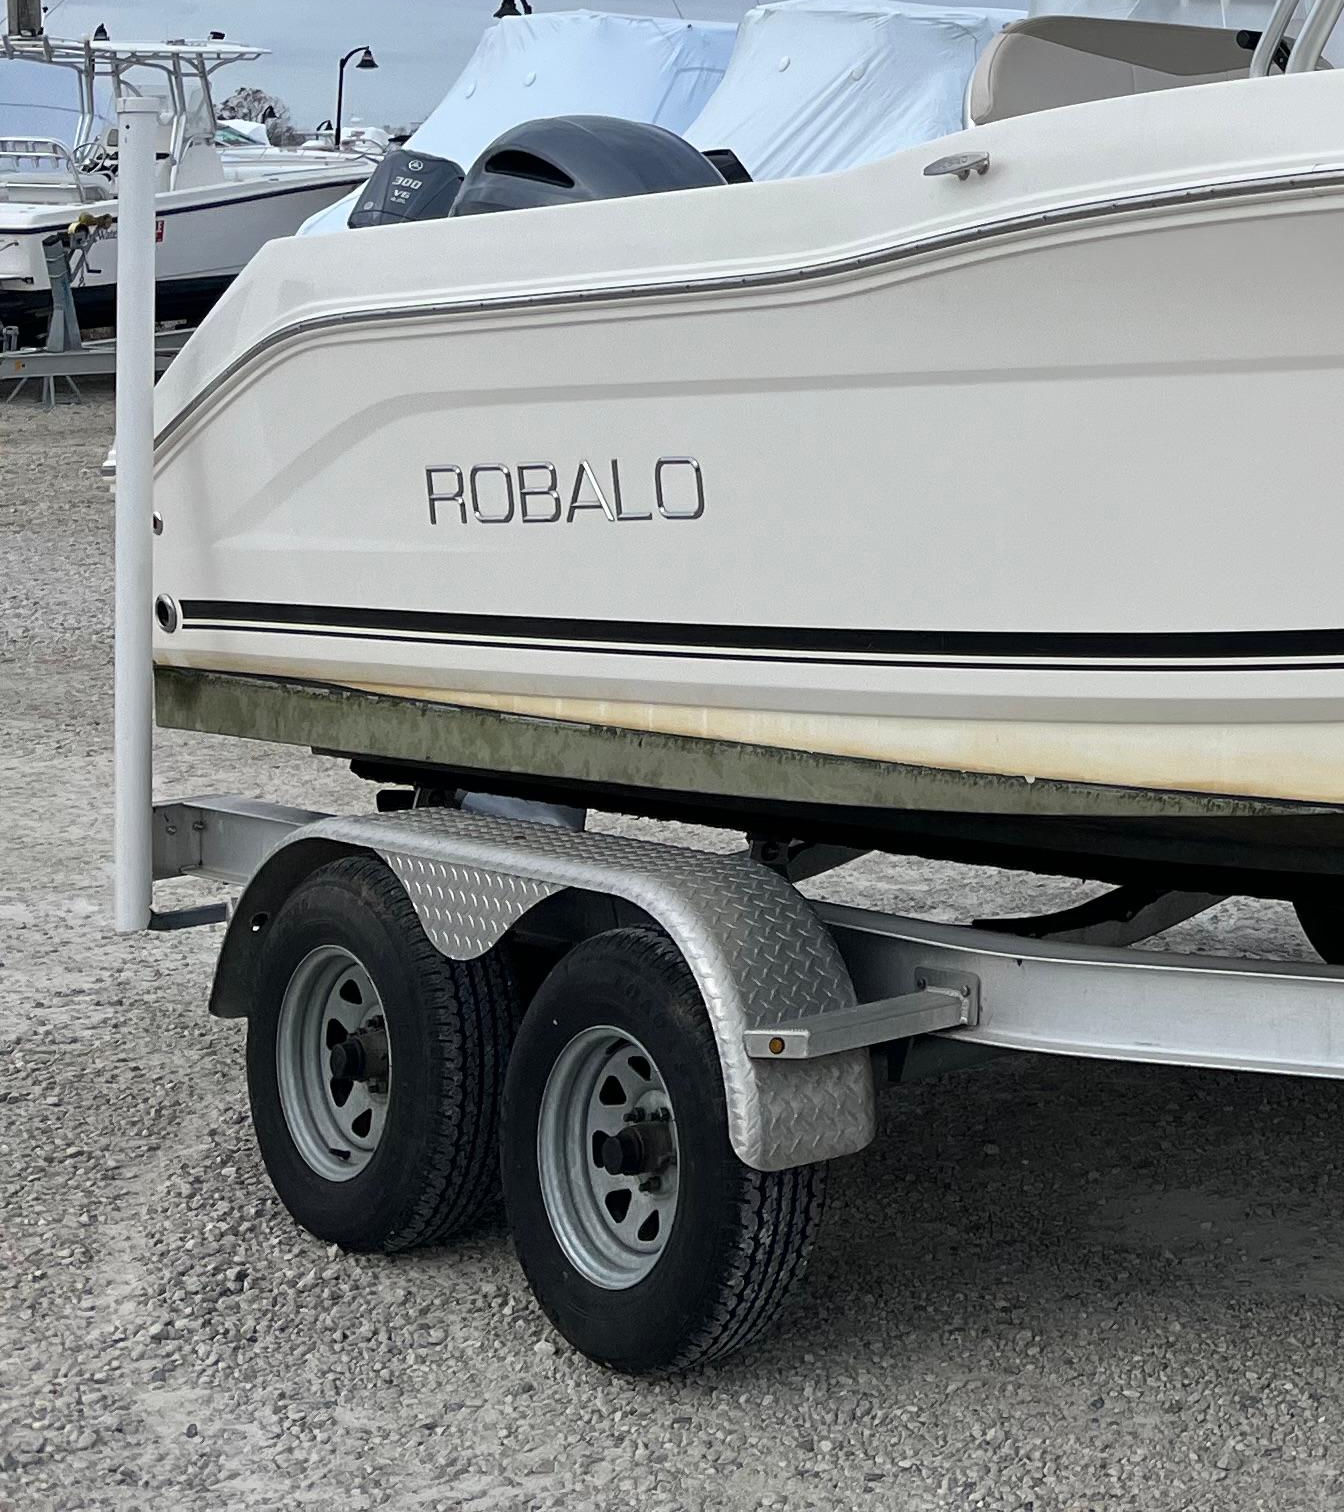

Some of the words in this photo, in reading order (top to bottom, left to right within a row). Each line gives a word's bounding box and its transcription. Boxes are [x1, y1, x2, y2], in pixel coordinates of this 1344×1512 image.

[391, 176, 423, 189] 300
[393, 189, 410, 198] V6
[425, 456, 704, 525] ROBALO
